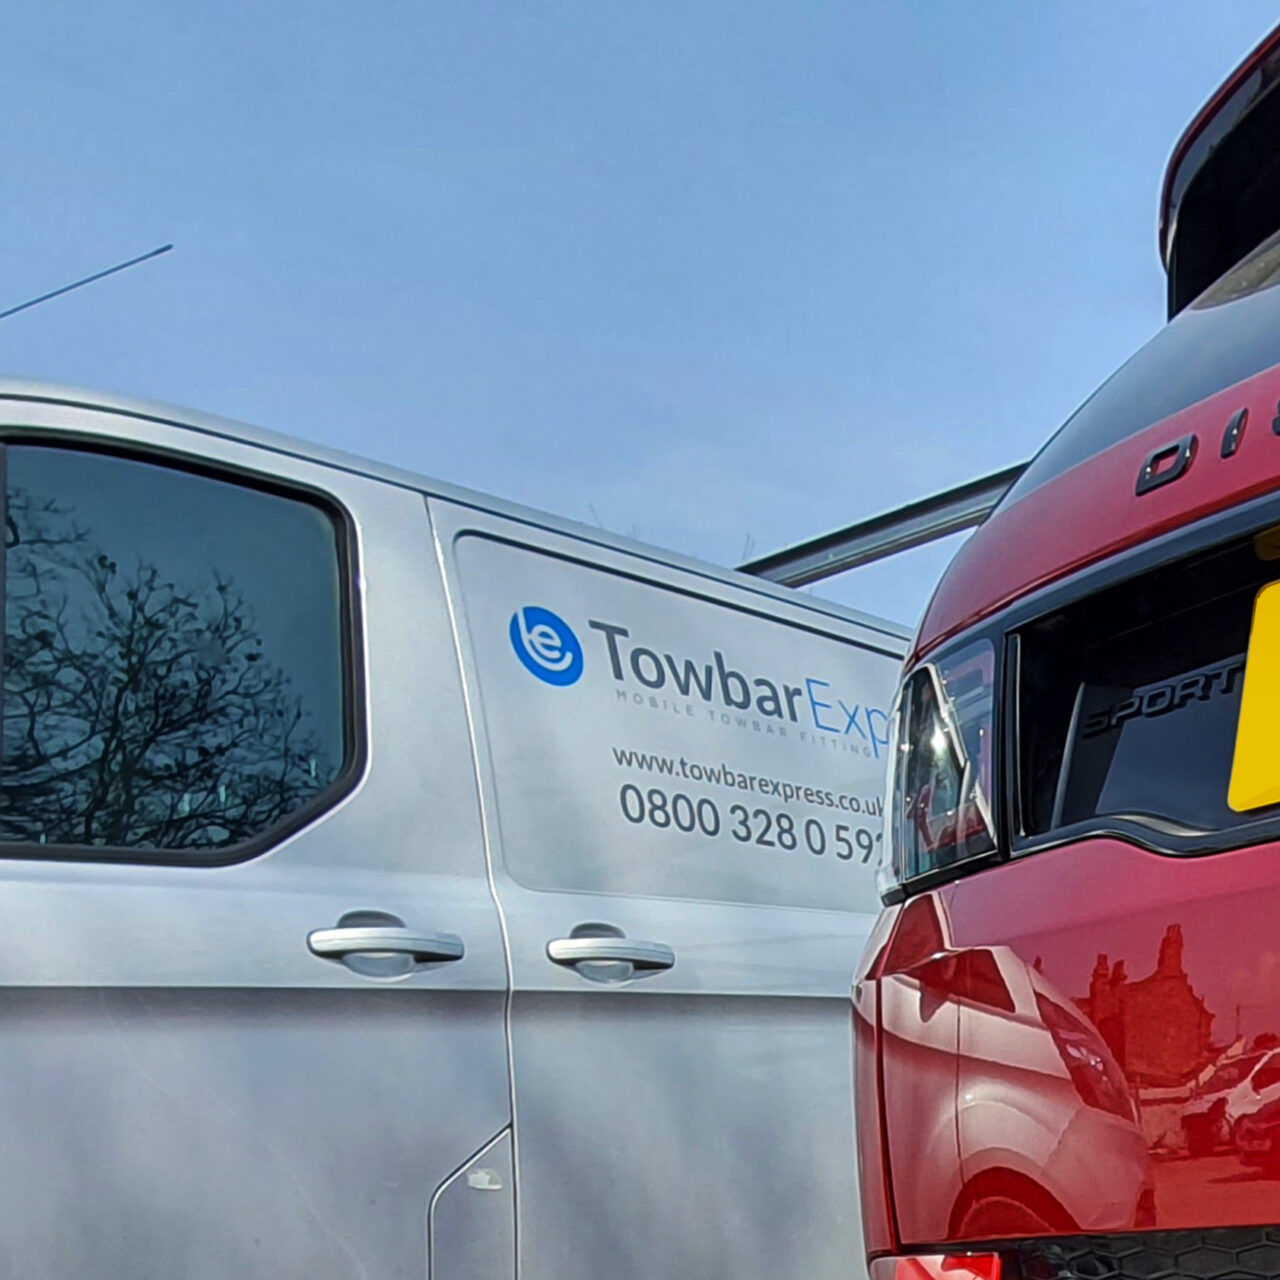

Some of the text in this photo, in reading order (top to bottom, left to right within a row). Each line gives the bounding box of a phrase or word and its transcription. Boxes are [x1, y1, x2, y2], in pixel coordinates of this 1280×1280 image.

[616, 688, 873, 758] MOBILE TOWBAR FITTING
[1082, 661, 1246, 739] SPORT
[619, 783, 883, 867] 0800 328 0 59
